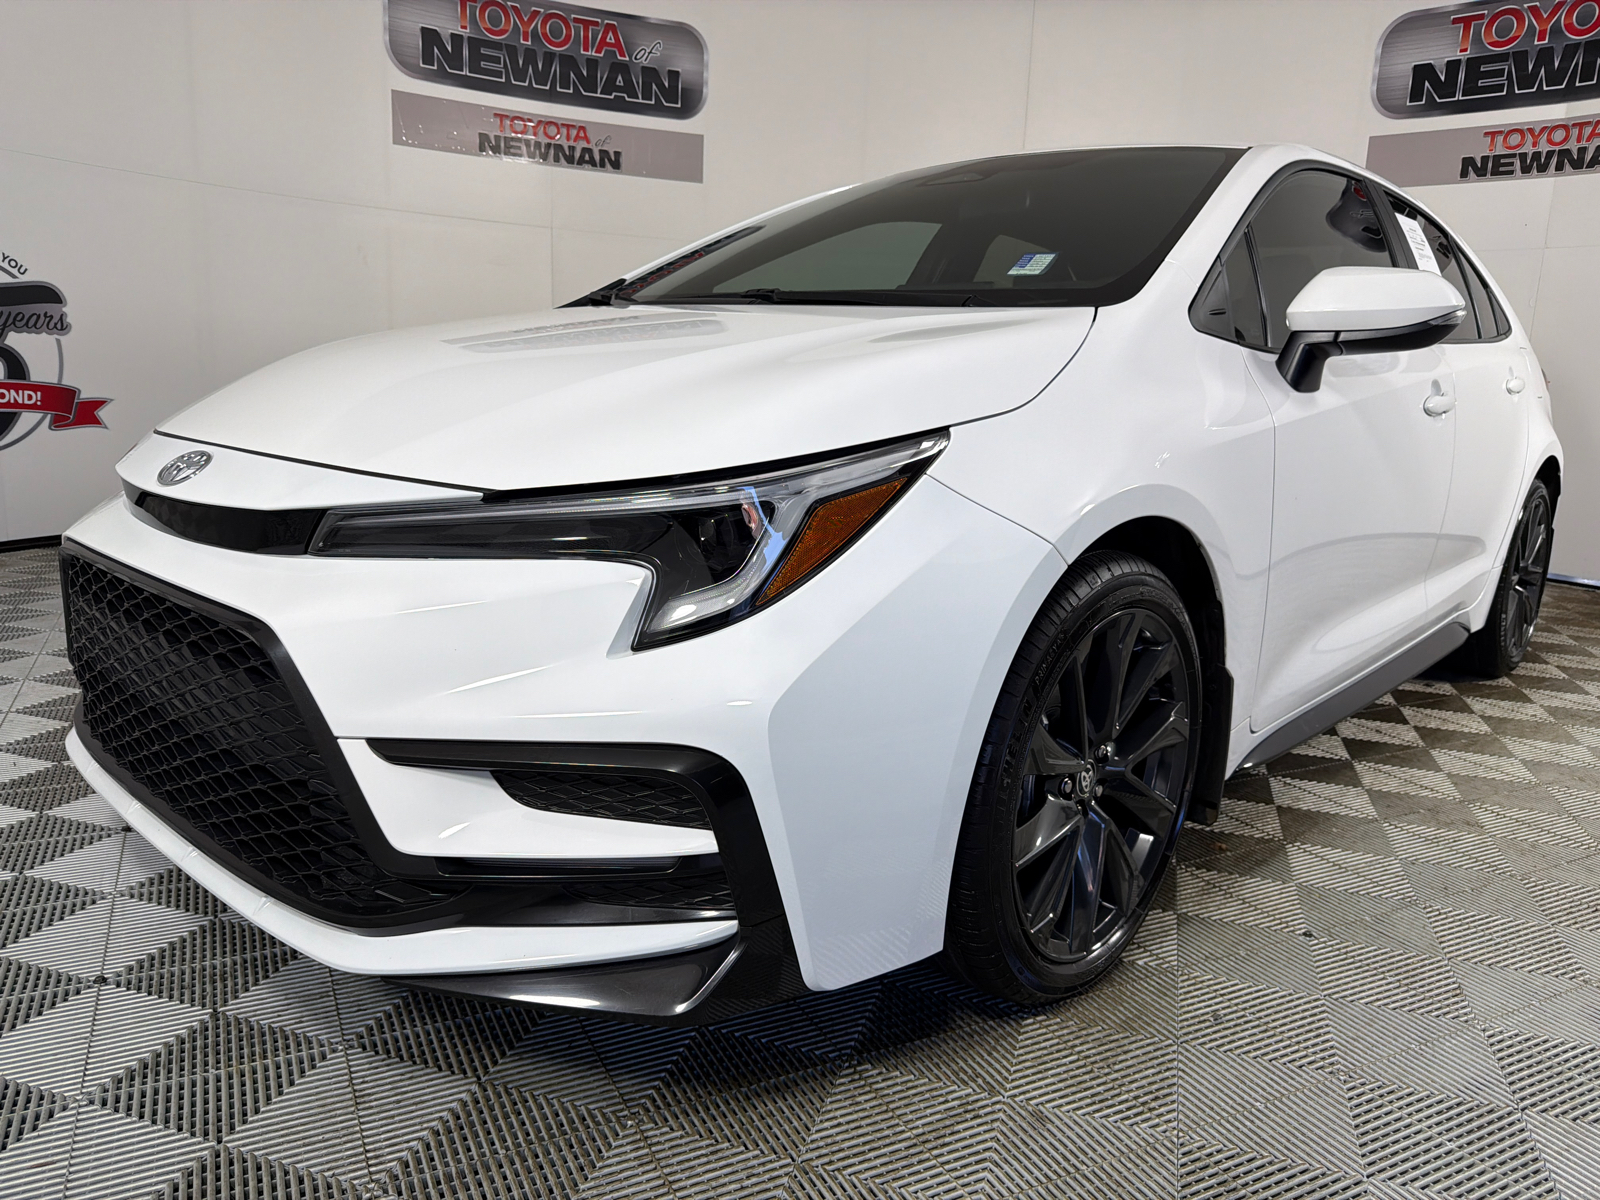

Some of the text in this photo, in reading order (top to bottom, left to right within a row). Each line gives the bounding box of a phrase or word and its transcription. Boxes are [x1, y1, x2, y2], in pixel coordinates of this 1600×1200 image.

[456, 0, 662, 62] TOYOTA of
[1451, 0, 1600, 55] TOYO
[419, 26, 682, 107] NEWNAN
[493, 112, 591, 145] TOYOTA
[478, 132, 622, 171] NEWNAN
[1, 252, 28, 276] YOU
[0, 310, 68, 337] years
